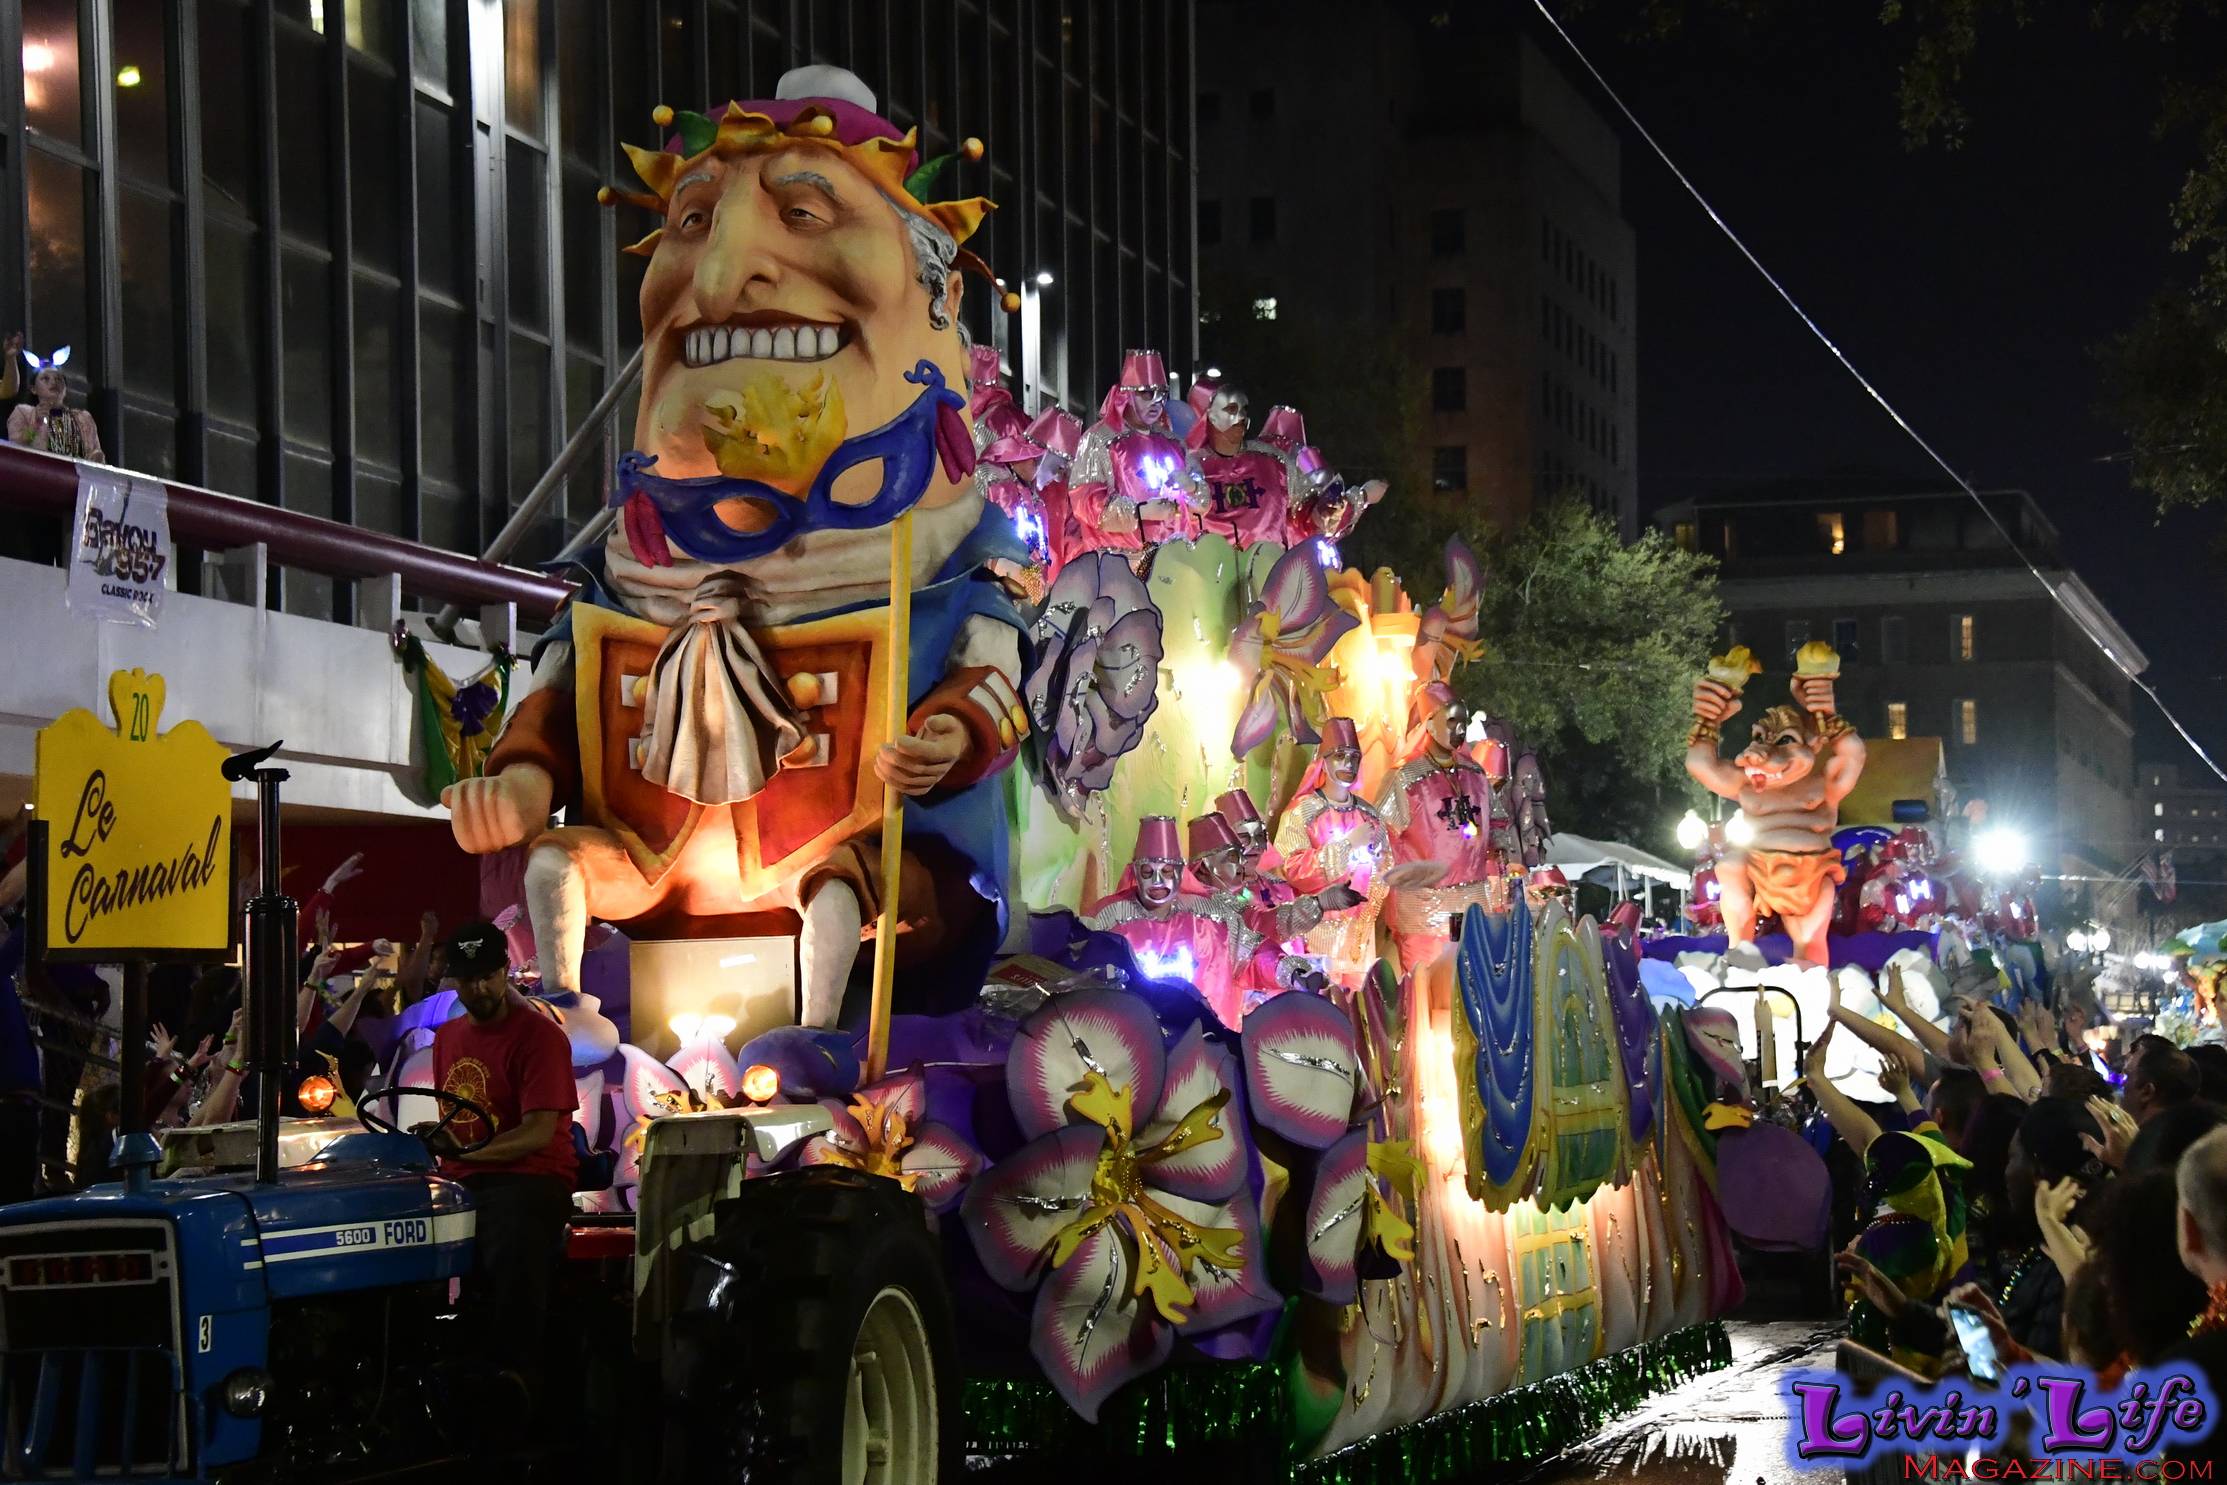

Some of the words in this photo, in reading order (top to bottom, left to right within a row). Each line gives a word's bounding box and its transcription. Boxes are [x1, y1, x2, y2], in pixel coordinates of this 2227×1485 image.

[84, 507, 158, 556] Bayou
[101, 583, 133, 600] CLASSIC
[129, 691, 150, 743] 20
[60, 768, 117, 859] Le
[64, 814, 222, 944] Carnaval
[335, 1228, 371, 1246] 5600
[383, 1219, 428, 1246] FORD
[200, 1315, 210, 1351] 3
